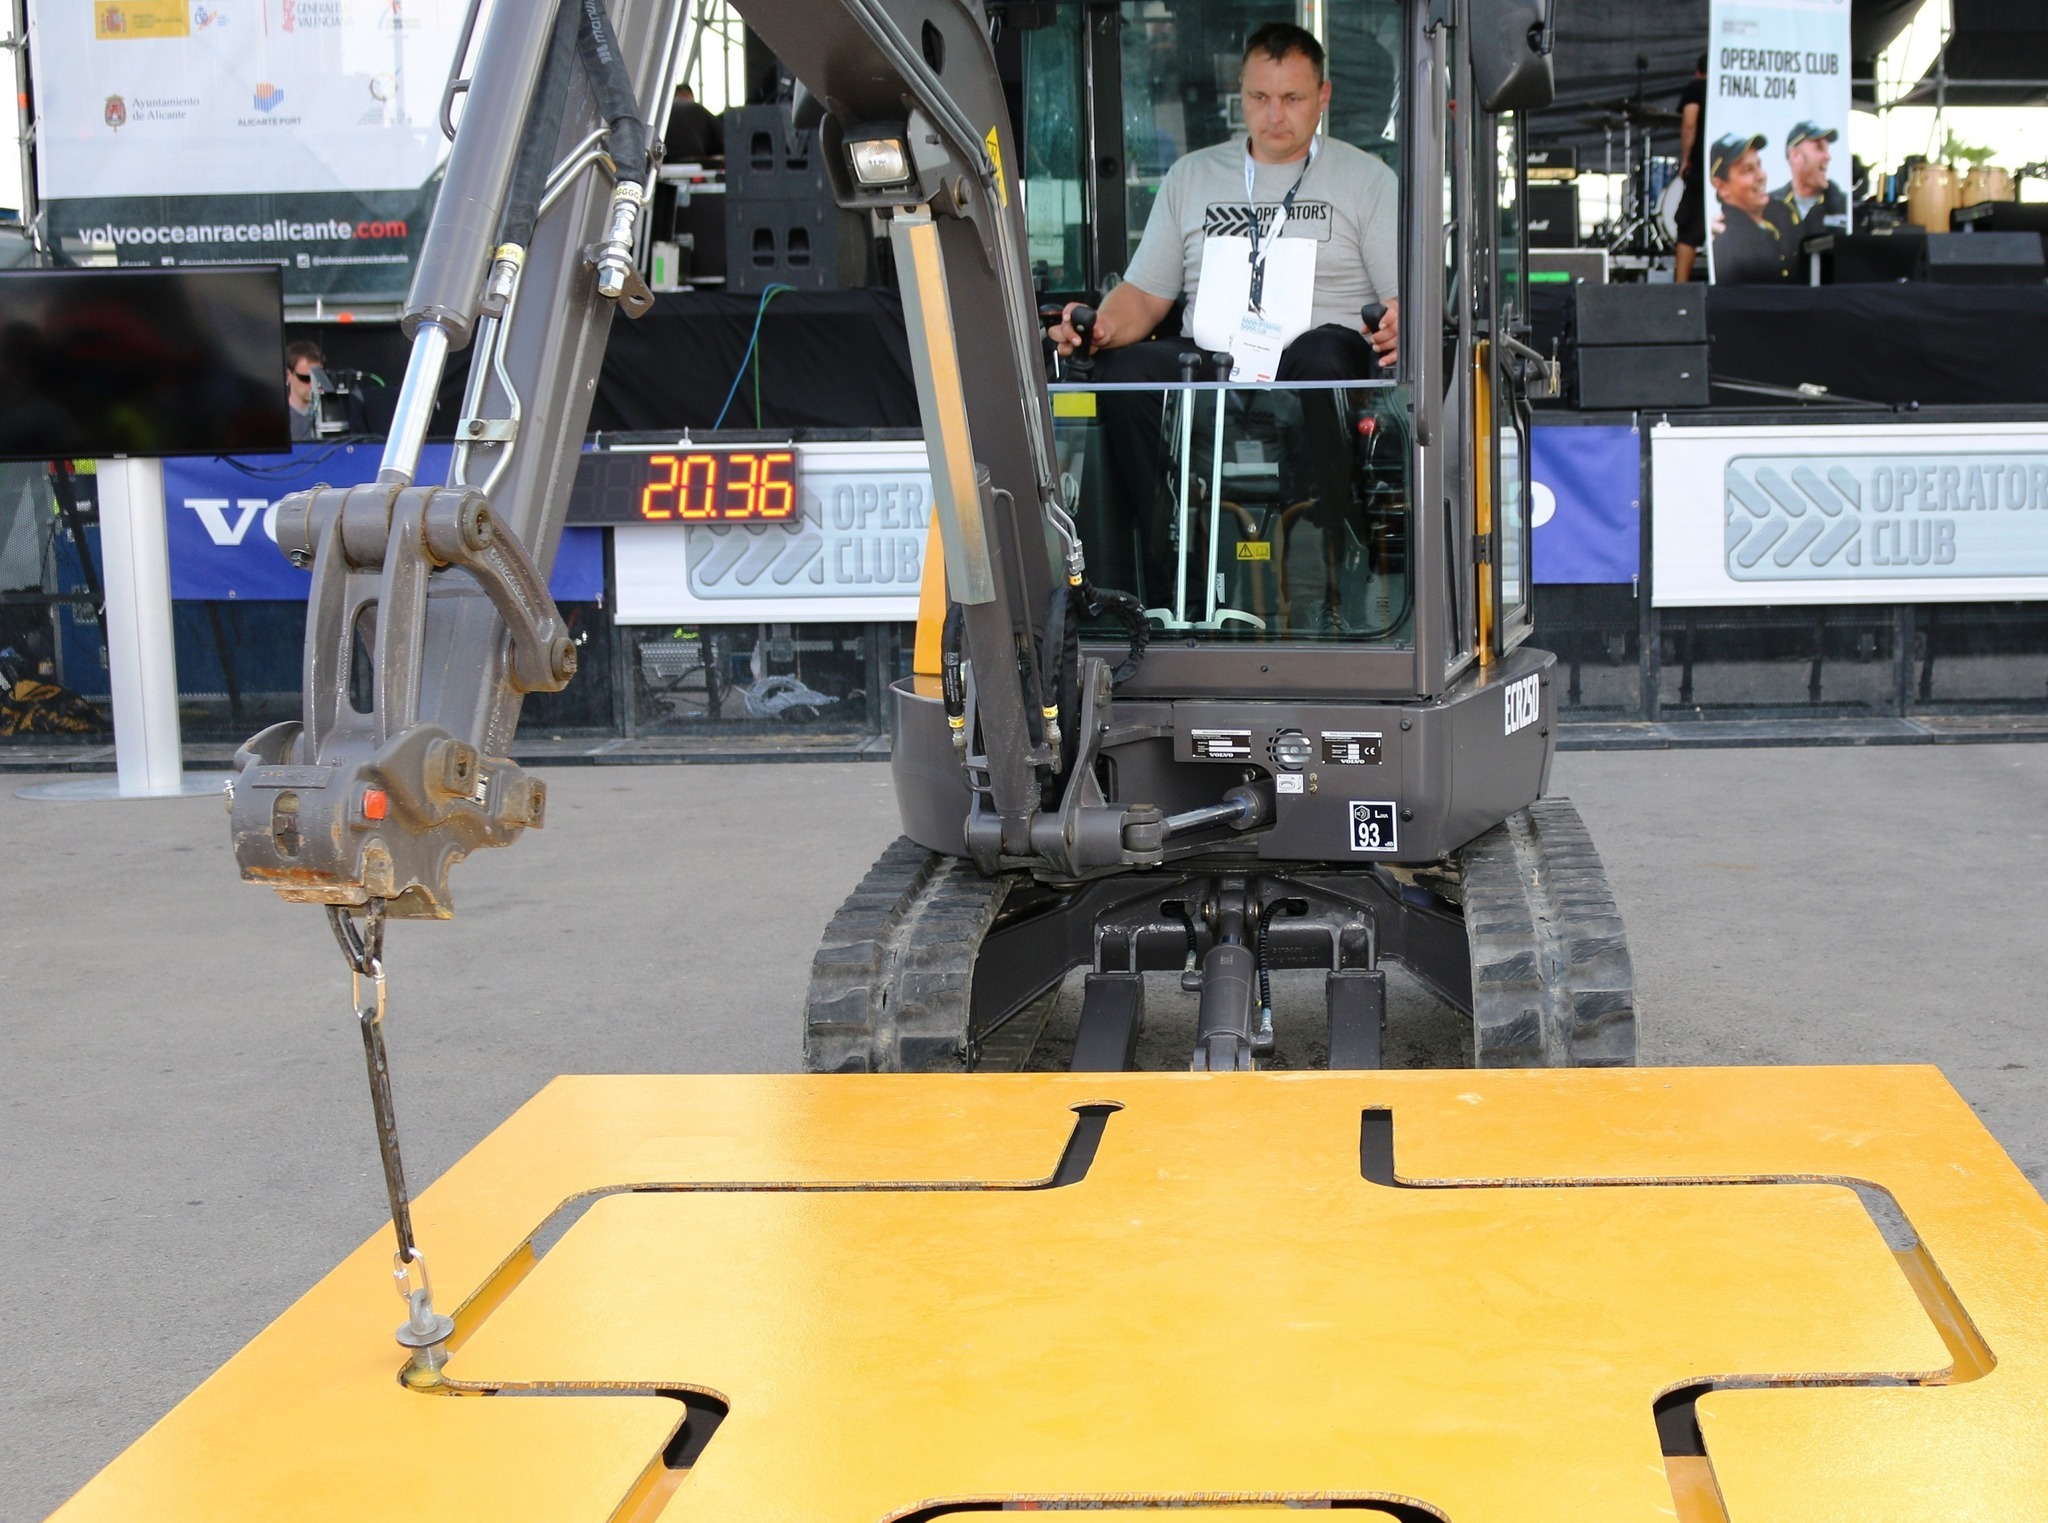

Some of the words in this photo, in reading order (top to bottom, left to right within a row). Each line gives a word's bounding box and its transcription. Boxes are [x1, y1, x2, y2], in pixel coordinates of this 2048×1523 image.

[1720, 48, 1802, 73] OPERATORS
[1805, 52, 1839, 75] CLUB
[1719, 75, 1759, 98] FINAL
[1764, 77, 1797, 99] 2014
[132, 97, 200, 109] Ayuntamiento
[132, 111, 144, 121] de
[147, 109, 187, 120] Alicante
[237, 117, 279, 127] ALICANTE
[1256, 205, 1327, 222] OPEATORS
[79, 218, 409, 245] volvooceanracealicante.com
[642, 453, 793, 519] 20.36
[832, 483, 931, 530] OPER
[1871, 519, 1957, 566] CLUB
[833, 536, 920, 585] CLUB
[1505, 673, 1540, 736] ECR25D
[1358, 822, 1380, 848] 93
